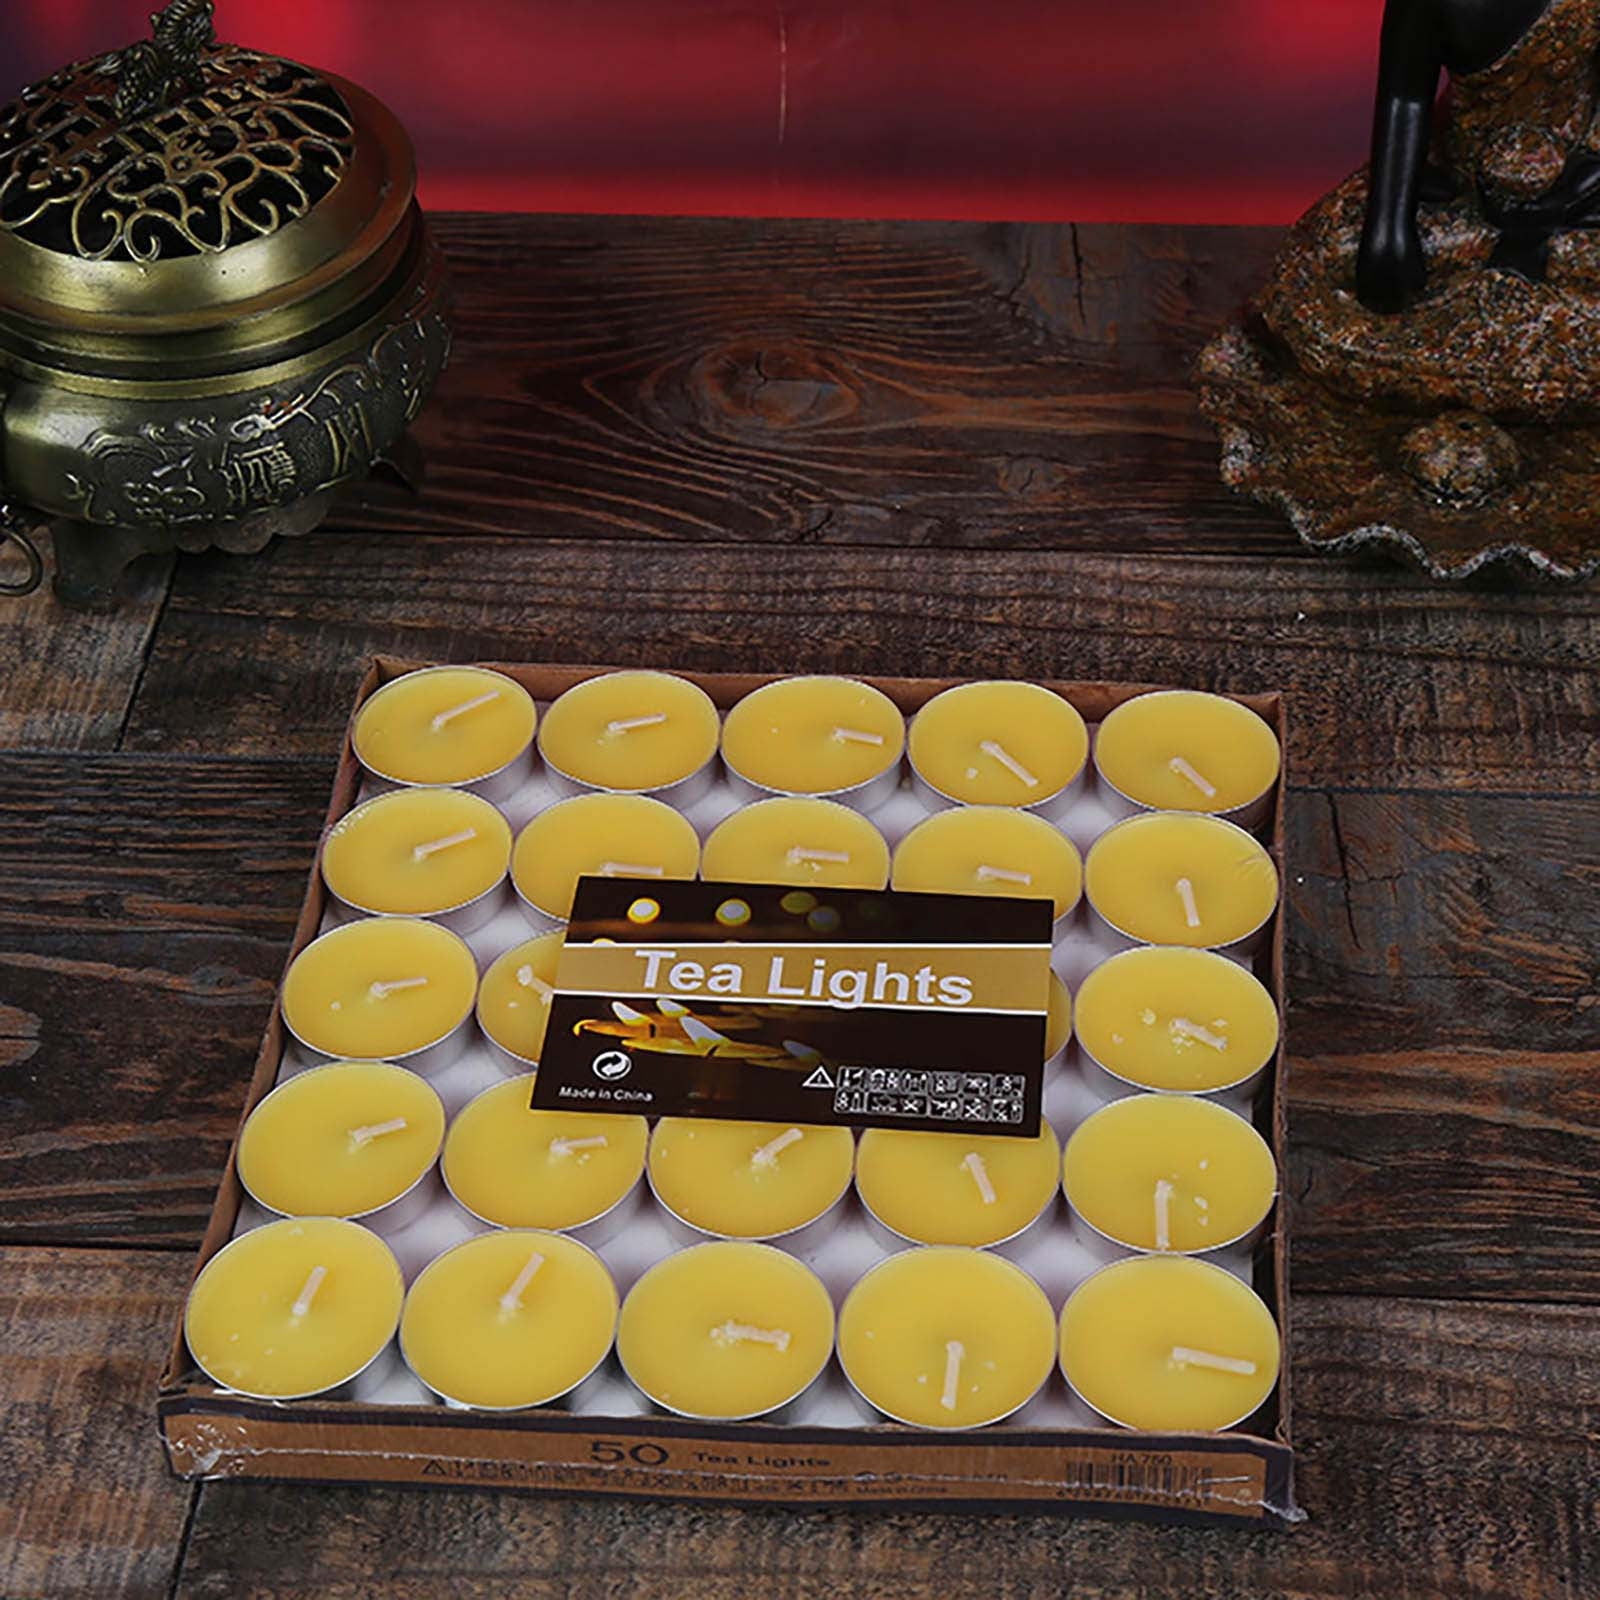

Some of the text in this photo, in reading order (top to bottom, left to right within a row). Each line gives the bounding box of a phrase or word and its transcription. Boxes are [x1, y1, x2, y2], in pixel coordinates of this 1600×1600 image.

[634, 950, 973, 1009] Tea Lights
[559, 1086, 596, 1098] Made
[613, 1089, 653, 1102] China
[590, 1440, 830, 1469] 50 Tea Lights
